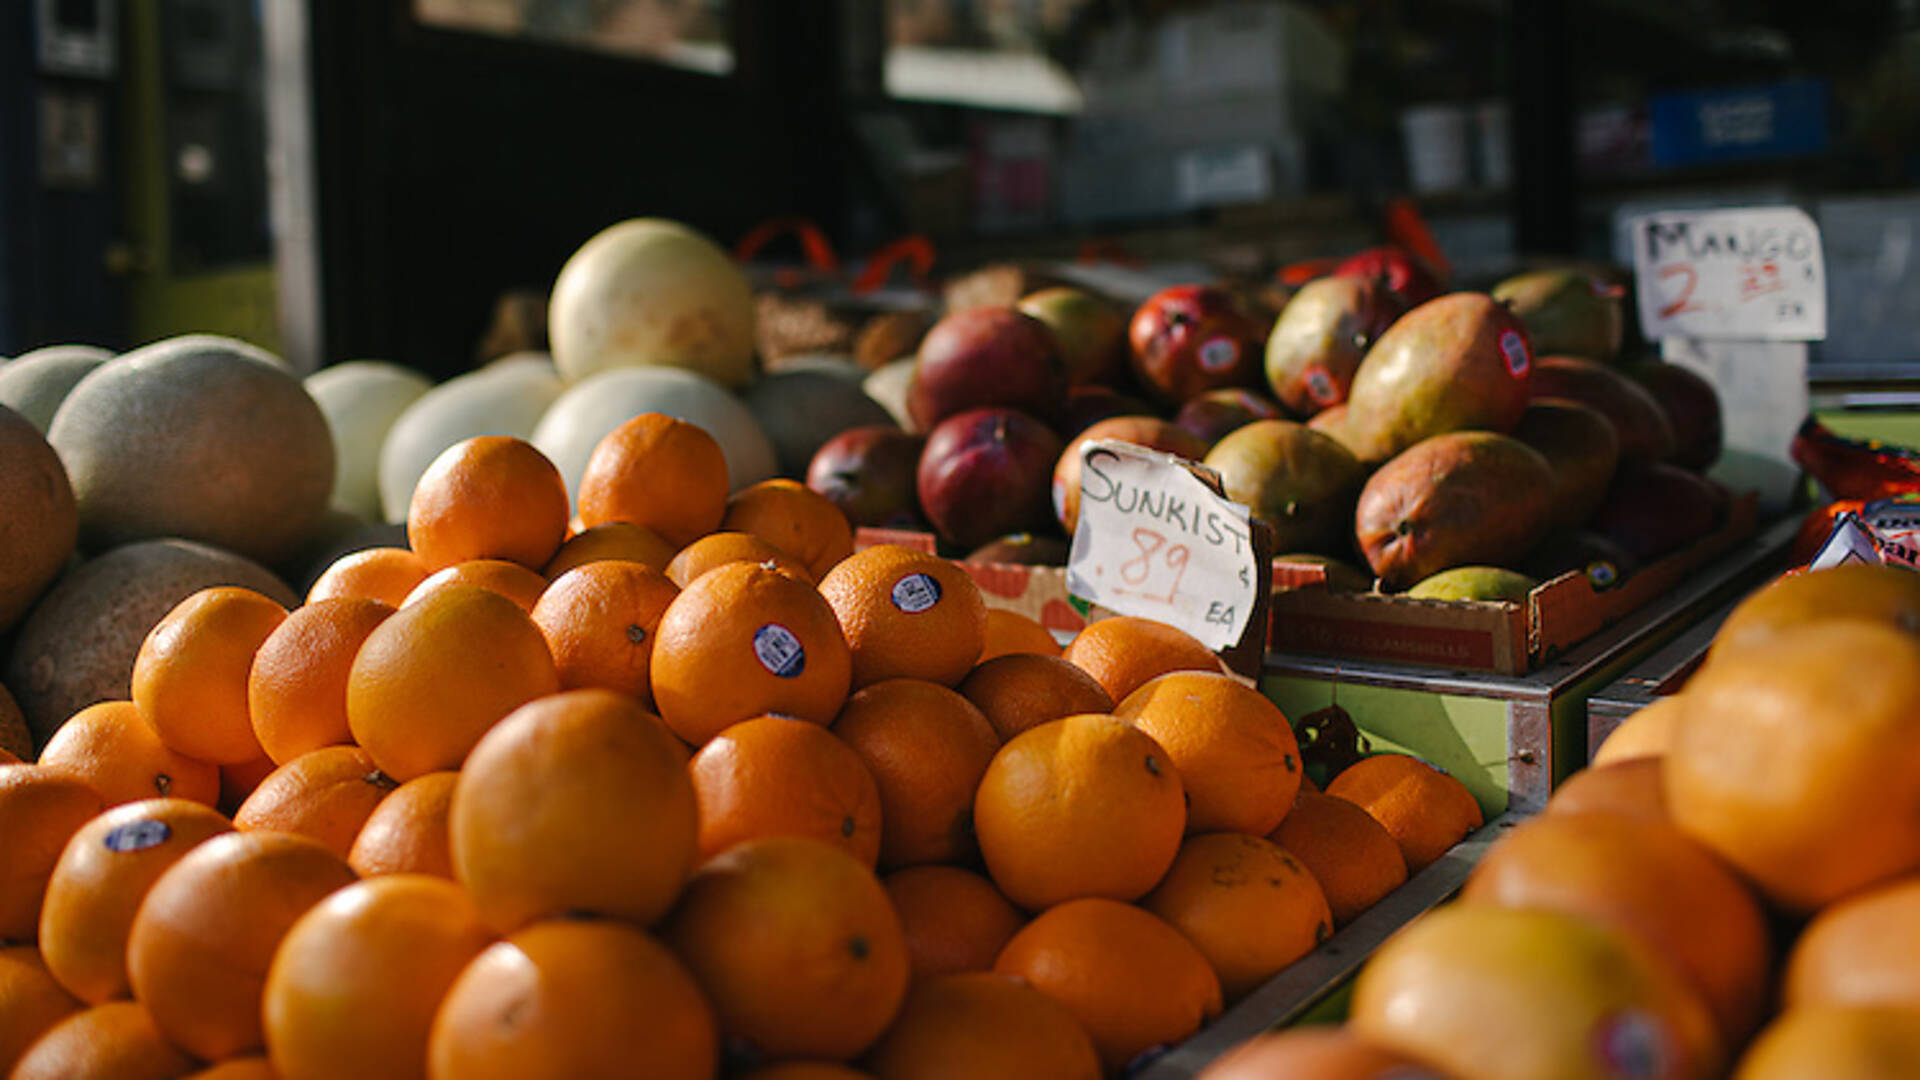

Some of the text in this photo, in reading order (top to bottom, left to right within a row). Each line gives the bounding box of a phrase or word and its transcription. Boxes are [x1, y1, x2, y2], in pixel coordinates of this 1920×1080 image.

[1647, 221, 1812, 262] MANGO
[1082, 449, 1248, 555] SUNKIST
[1205, 601, 1236, 634] EA
